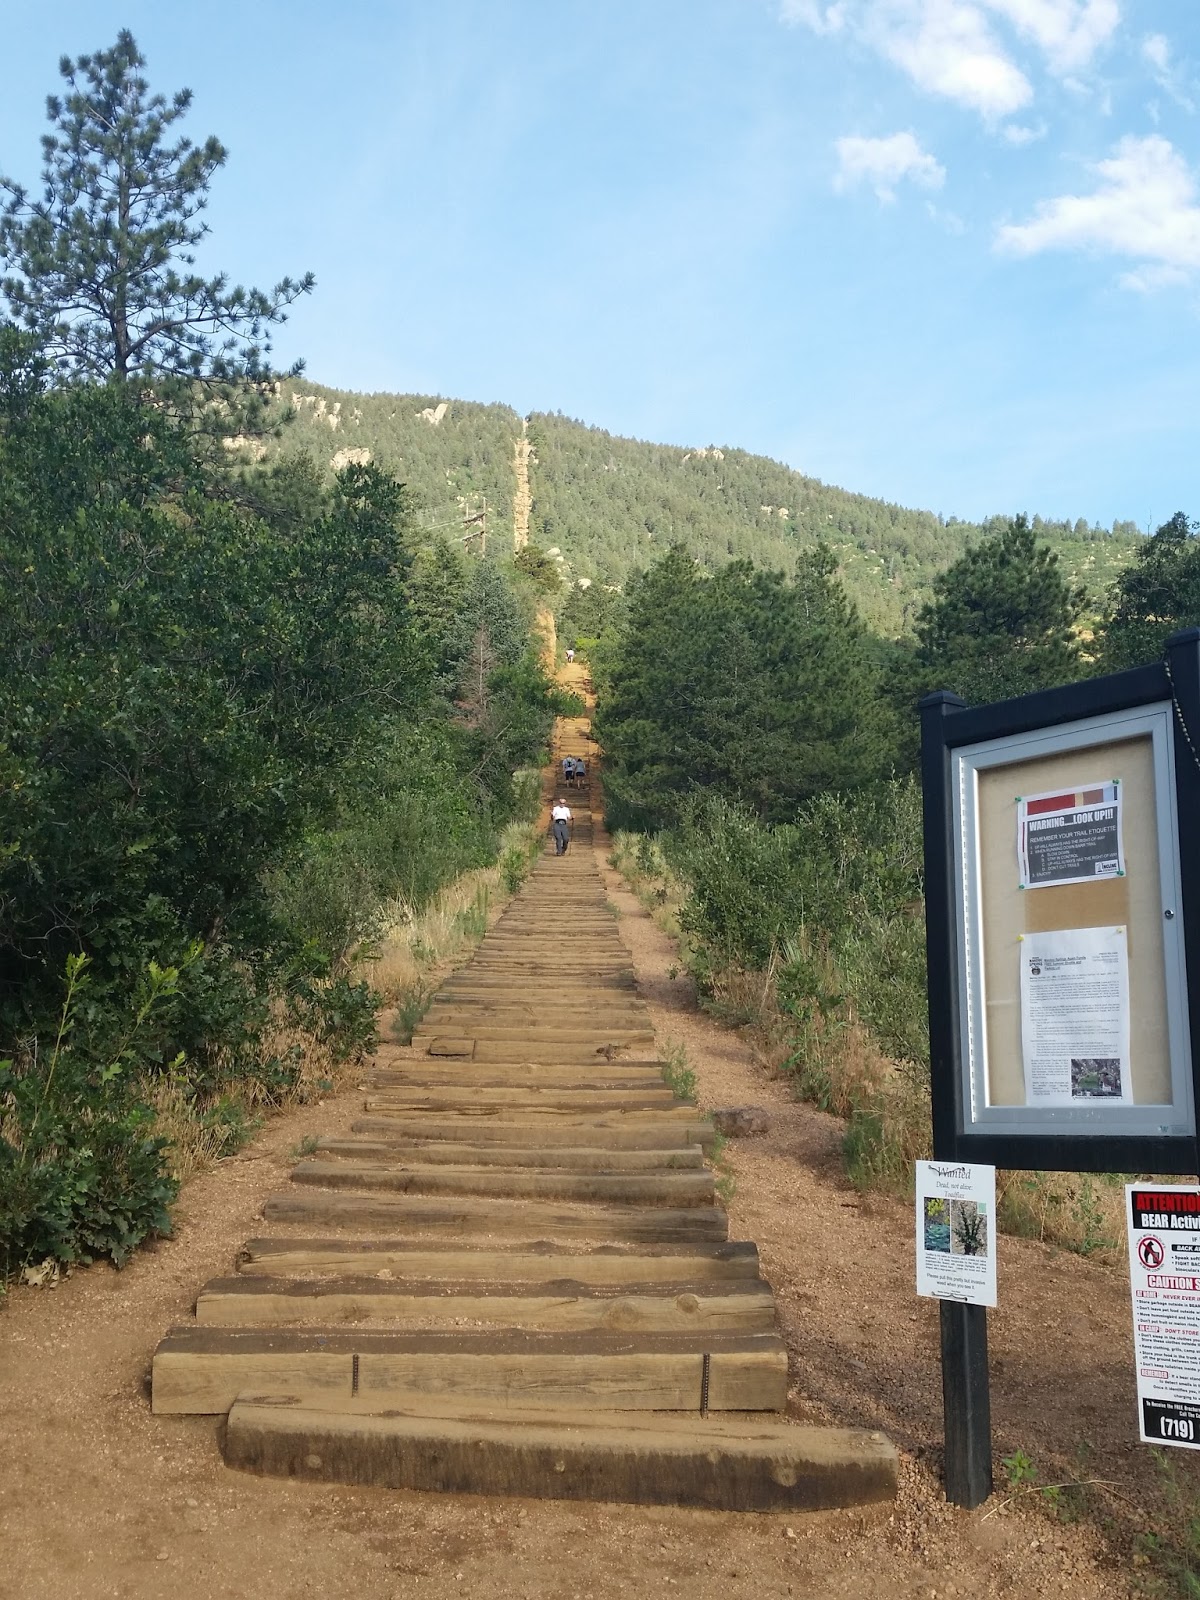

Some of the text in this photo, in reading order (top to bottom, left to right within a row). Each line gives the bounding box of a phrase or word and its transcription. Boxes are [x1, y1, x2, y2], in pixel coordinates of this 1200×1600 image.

[1030, 834, 1058, 843] REMEMBER
[1089, 825, 1116, 834] ETIQUETTE
[938, 1166, 971, 1179] Wanted
[1141, 1213, 1169, 1228] BEAR
[1148, 1276, 1194, 1290] CAUTION
[1160, 1416, 1194, 1440] (719)
